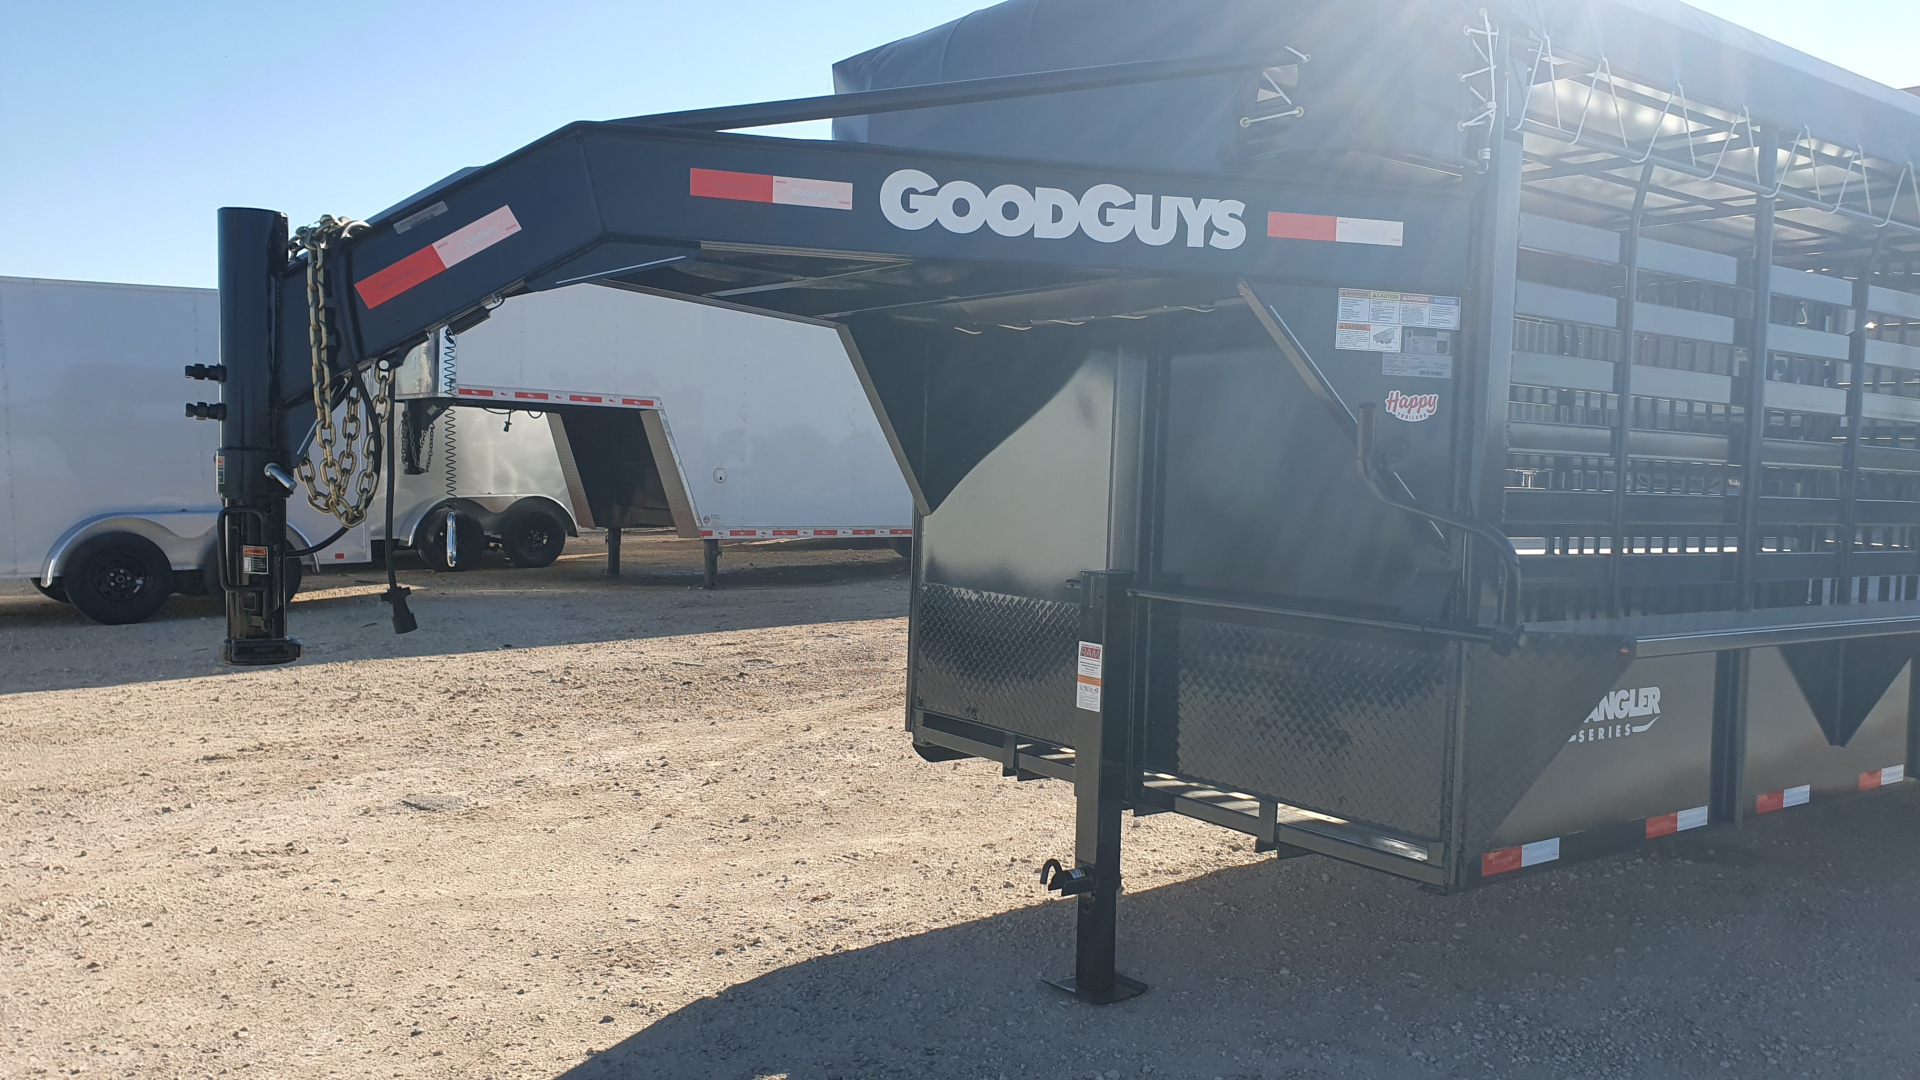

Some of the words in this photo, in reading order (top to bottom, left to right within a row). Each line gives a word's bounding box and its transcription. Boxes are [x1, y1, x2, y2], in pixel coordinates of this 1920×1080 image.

[880, 169, 1247, 250] GOODGUYS
[1386, 391, 1438, 414] Happy
[1397, 412, 1427, 420] TRAILERS
[1080, 646, 1101, 659] RAM
[1578, 723, 1631, 743] SERIES
